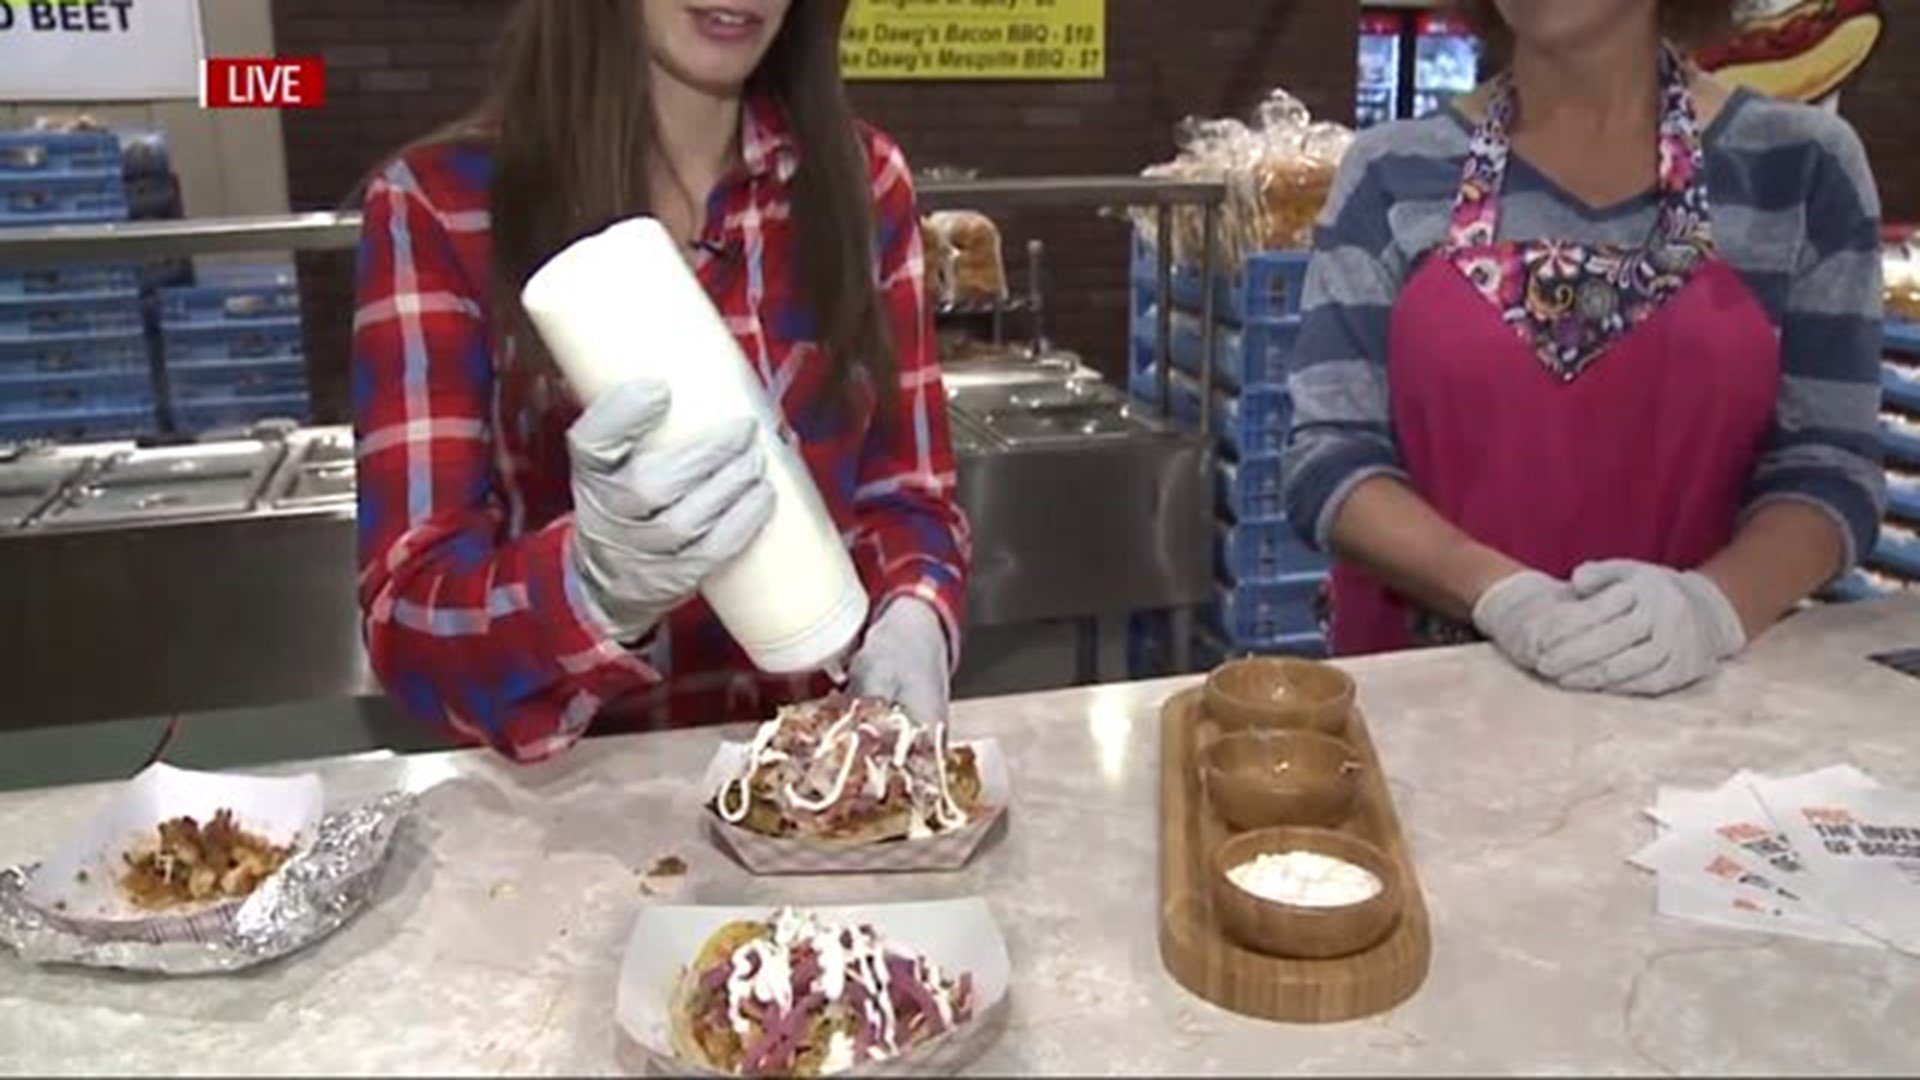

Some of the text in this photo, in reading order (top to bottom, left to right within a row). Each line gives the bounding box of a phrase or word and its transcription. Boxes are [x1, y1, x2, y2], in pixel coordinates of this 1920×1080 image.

[29, 0, 133, 31] BEET
[874, 24, 939, 47] Dawg's
[945, 23, 1002, 43] Bacon
[1007, 24, 1048, 44] BBQ
[866, 48, 932, 71] Dawg's
[937, 48, 1018, 71] Mesquite
[1023, 49, 1064, 69] BBQ
[1813, 823, 1856, 839] THE
[1823, 840, 1851, 855] OF
